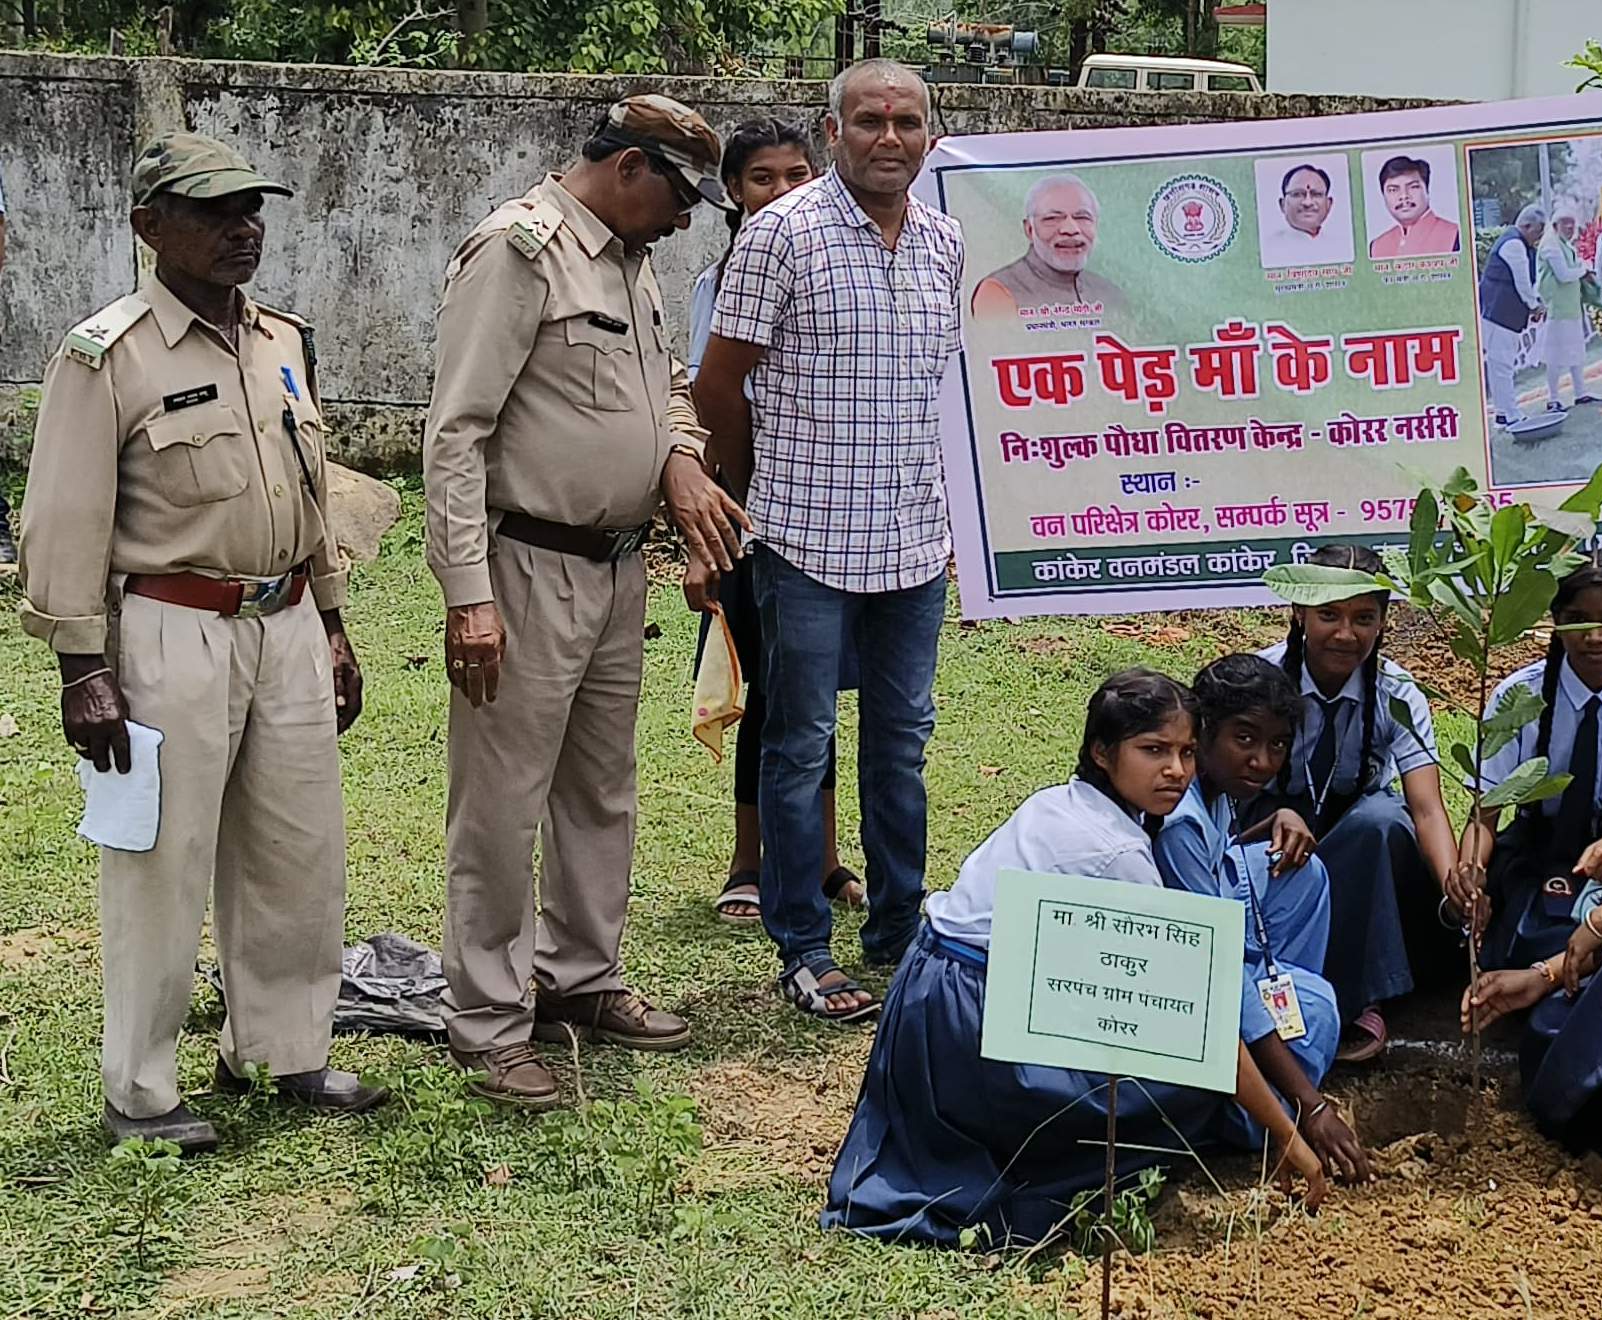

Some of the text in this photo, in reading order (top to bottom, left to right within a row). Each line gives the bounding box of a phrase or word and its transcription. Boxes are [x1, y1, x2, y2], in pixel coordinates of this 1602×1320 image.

[991, 320, 1460, 413] एक पेड़ माँ के नाम
[1103, 424, 1160, 456] पौधा
[1164, 422, 1247, 454] वितरण
[1250, 419, 1303, 449] केन्द्र
[1327, 412, 1388, 445] कोरर
[1393, 406, 1459, 440] नर्सरी
[1119, 471, 1176, 494] स्थान
[1030, 515, 1066, 537] वन
[1070, 506, 1140, 536] परिक्षेत्र
[1144, 502, 1210, 534] कोरर,
[1214, 496, 1288, 529] सम्पर्क
[1293, 501, 1329, 532] सूत्र
[1031, 552, 1102, 581] कांकेर
[1105, 551, 1201, 578] वनमंडल
[1084, 910, 1107, 932] श्री
[1112, 915, 1160, 940] सौरभ
[1166, 922, 1201, 947] सिंह
[1100, 951, 1149, 977] ठाकुर
[1047, 976, 1099, 999] सरपंच
[1138, 989, 1195, 1016] पंचायत
[1097, 1014, 1139, 1038] कोरर
